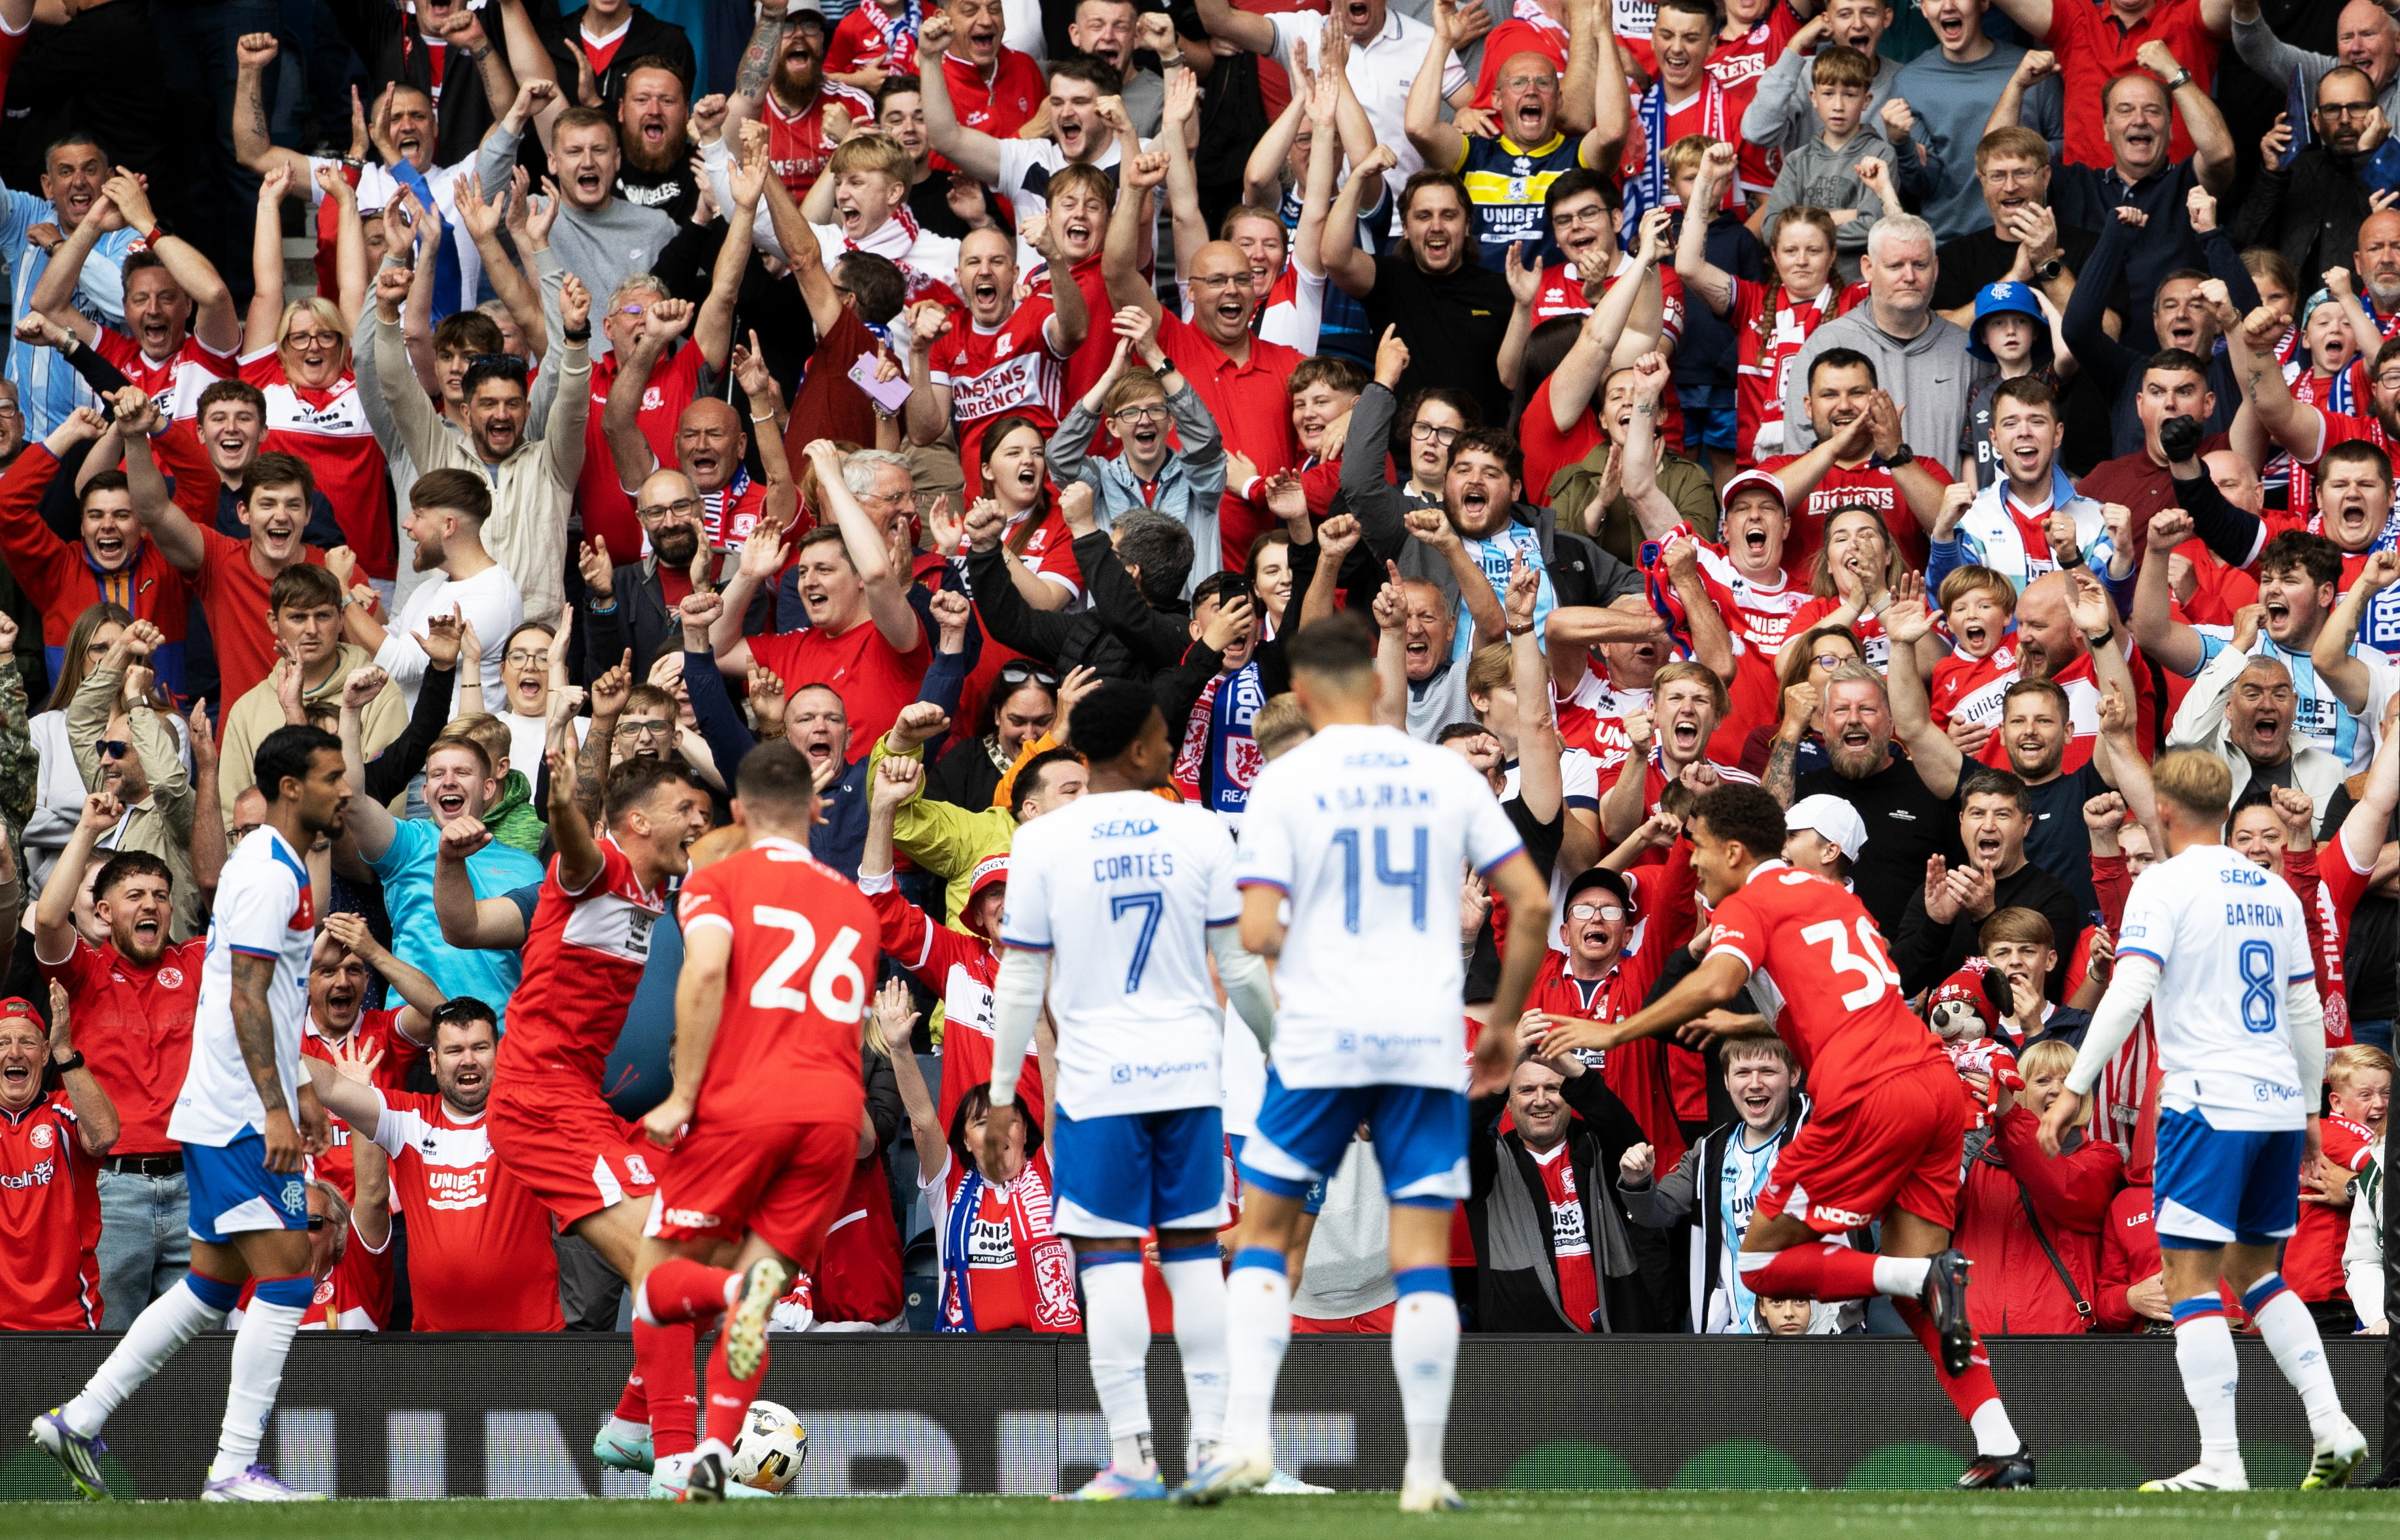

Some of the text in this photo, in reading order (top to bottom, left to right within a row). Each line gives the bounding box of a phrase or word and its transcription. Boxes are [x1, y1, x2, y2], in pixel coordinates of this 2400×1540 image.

[1482, 207, 1544, 223] UNIBET
[1090, 819, 1159, 840] SEKO
[1330, 826, 1429, 936] 14
[2220, 868, 2267, 887] SEKO
[2226, 903, 2284, 928] BARRON
[1110, 891, 1163, 995] 7
[750, 904, 865, 1024] 26
[2239, 939, 2276, 1033] 8
[429, 1168, 487, 1190] UNIBET
[1813, 1205, 1871, 1227] NOCO
[2127, 1213, 2150, 1227] U.S.
[973, 1251, 1016, 1263] PLAYER SAFETY
